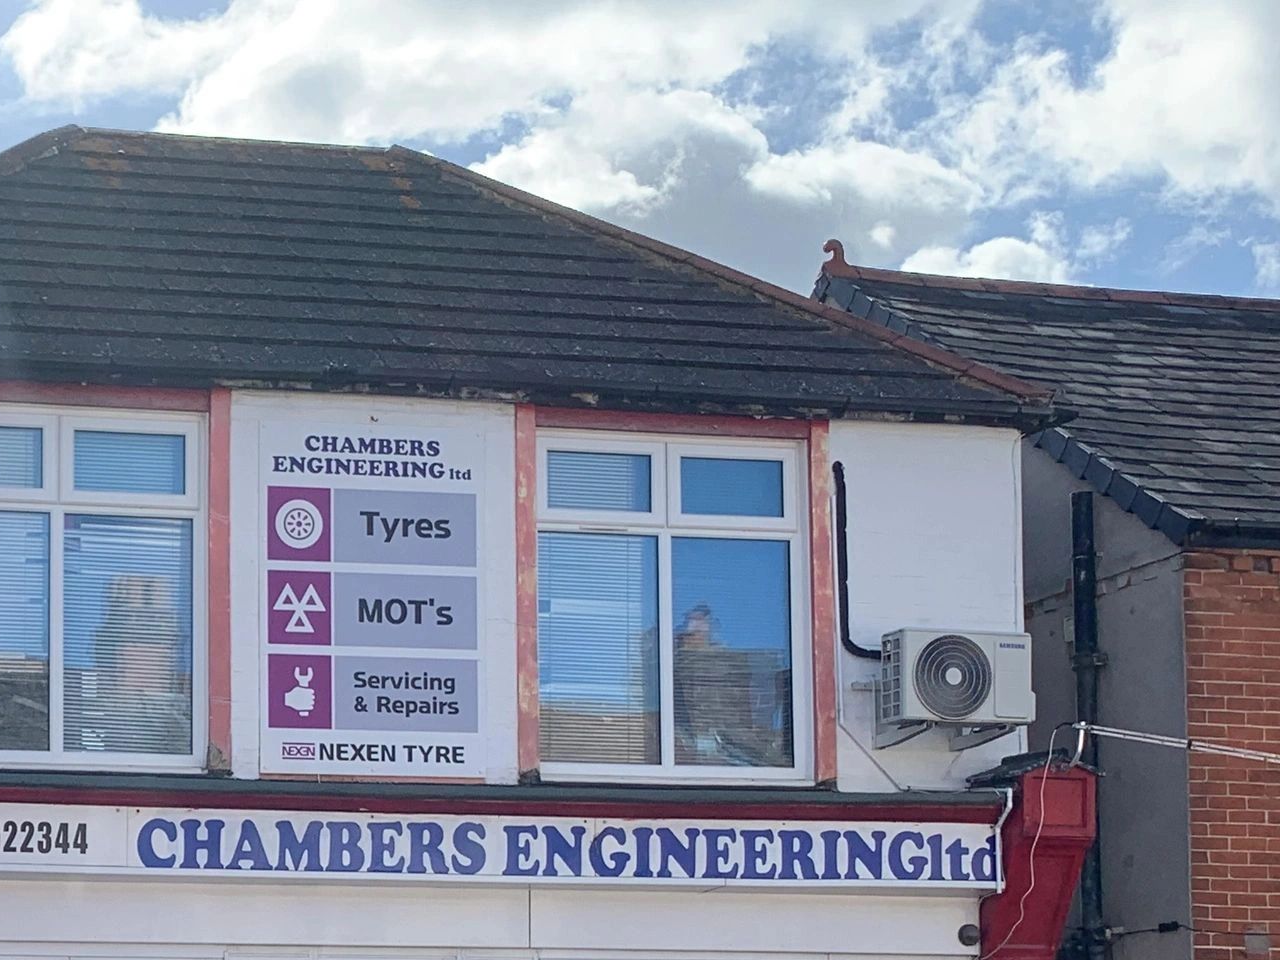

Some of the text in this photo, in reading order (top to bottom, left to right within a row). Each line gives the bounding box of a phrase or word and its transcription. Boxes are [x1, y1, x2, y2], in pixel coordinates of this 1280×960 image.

[305, 435, 440, 457] CHAMBERS
[272, 456, 472, 481] ENGINEERING ltd
[360, 511, 452, 543] Tyres
[358, 598, 454, 626] MOT's
[354, 671, 456, 695] Servicing
[354, 696, 460, 717] & Repairs
[319, 743, 396, 763] NEXEN
[403, 745, 466, 764] TYRE
[137, 818, 487, 876] CHAMBERS
